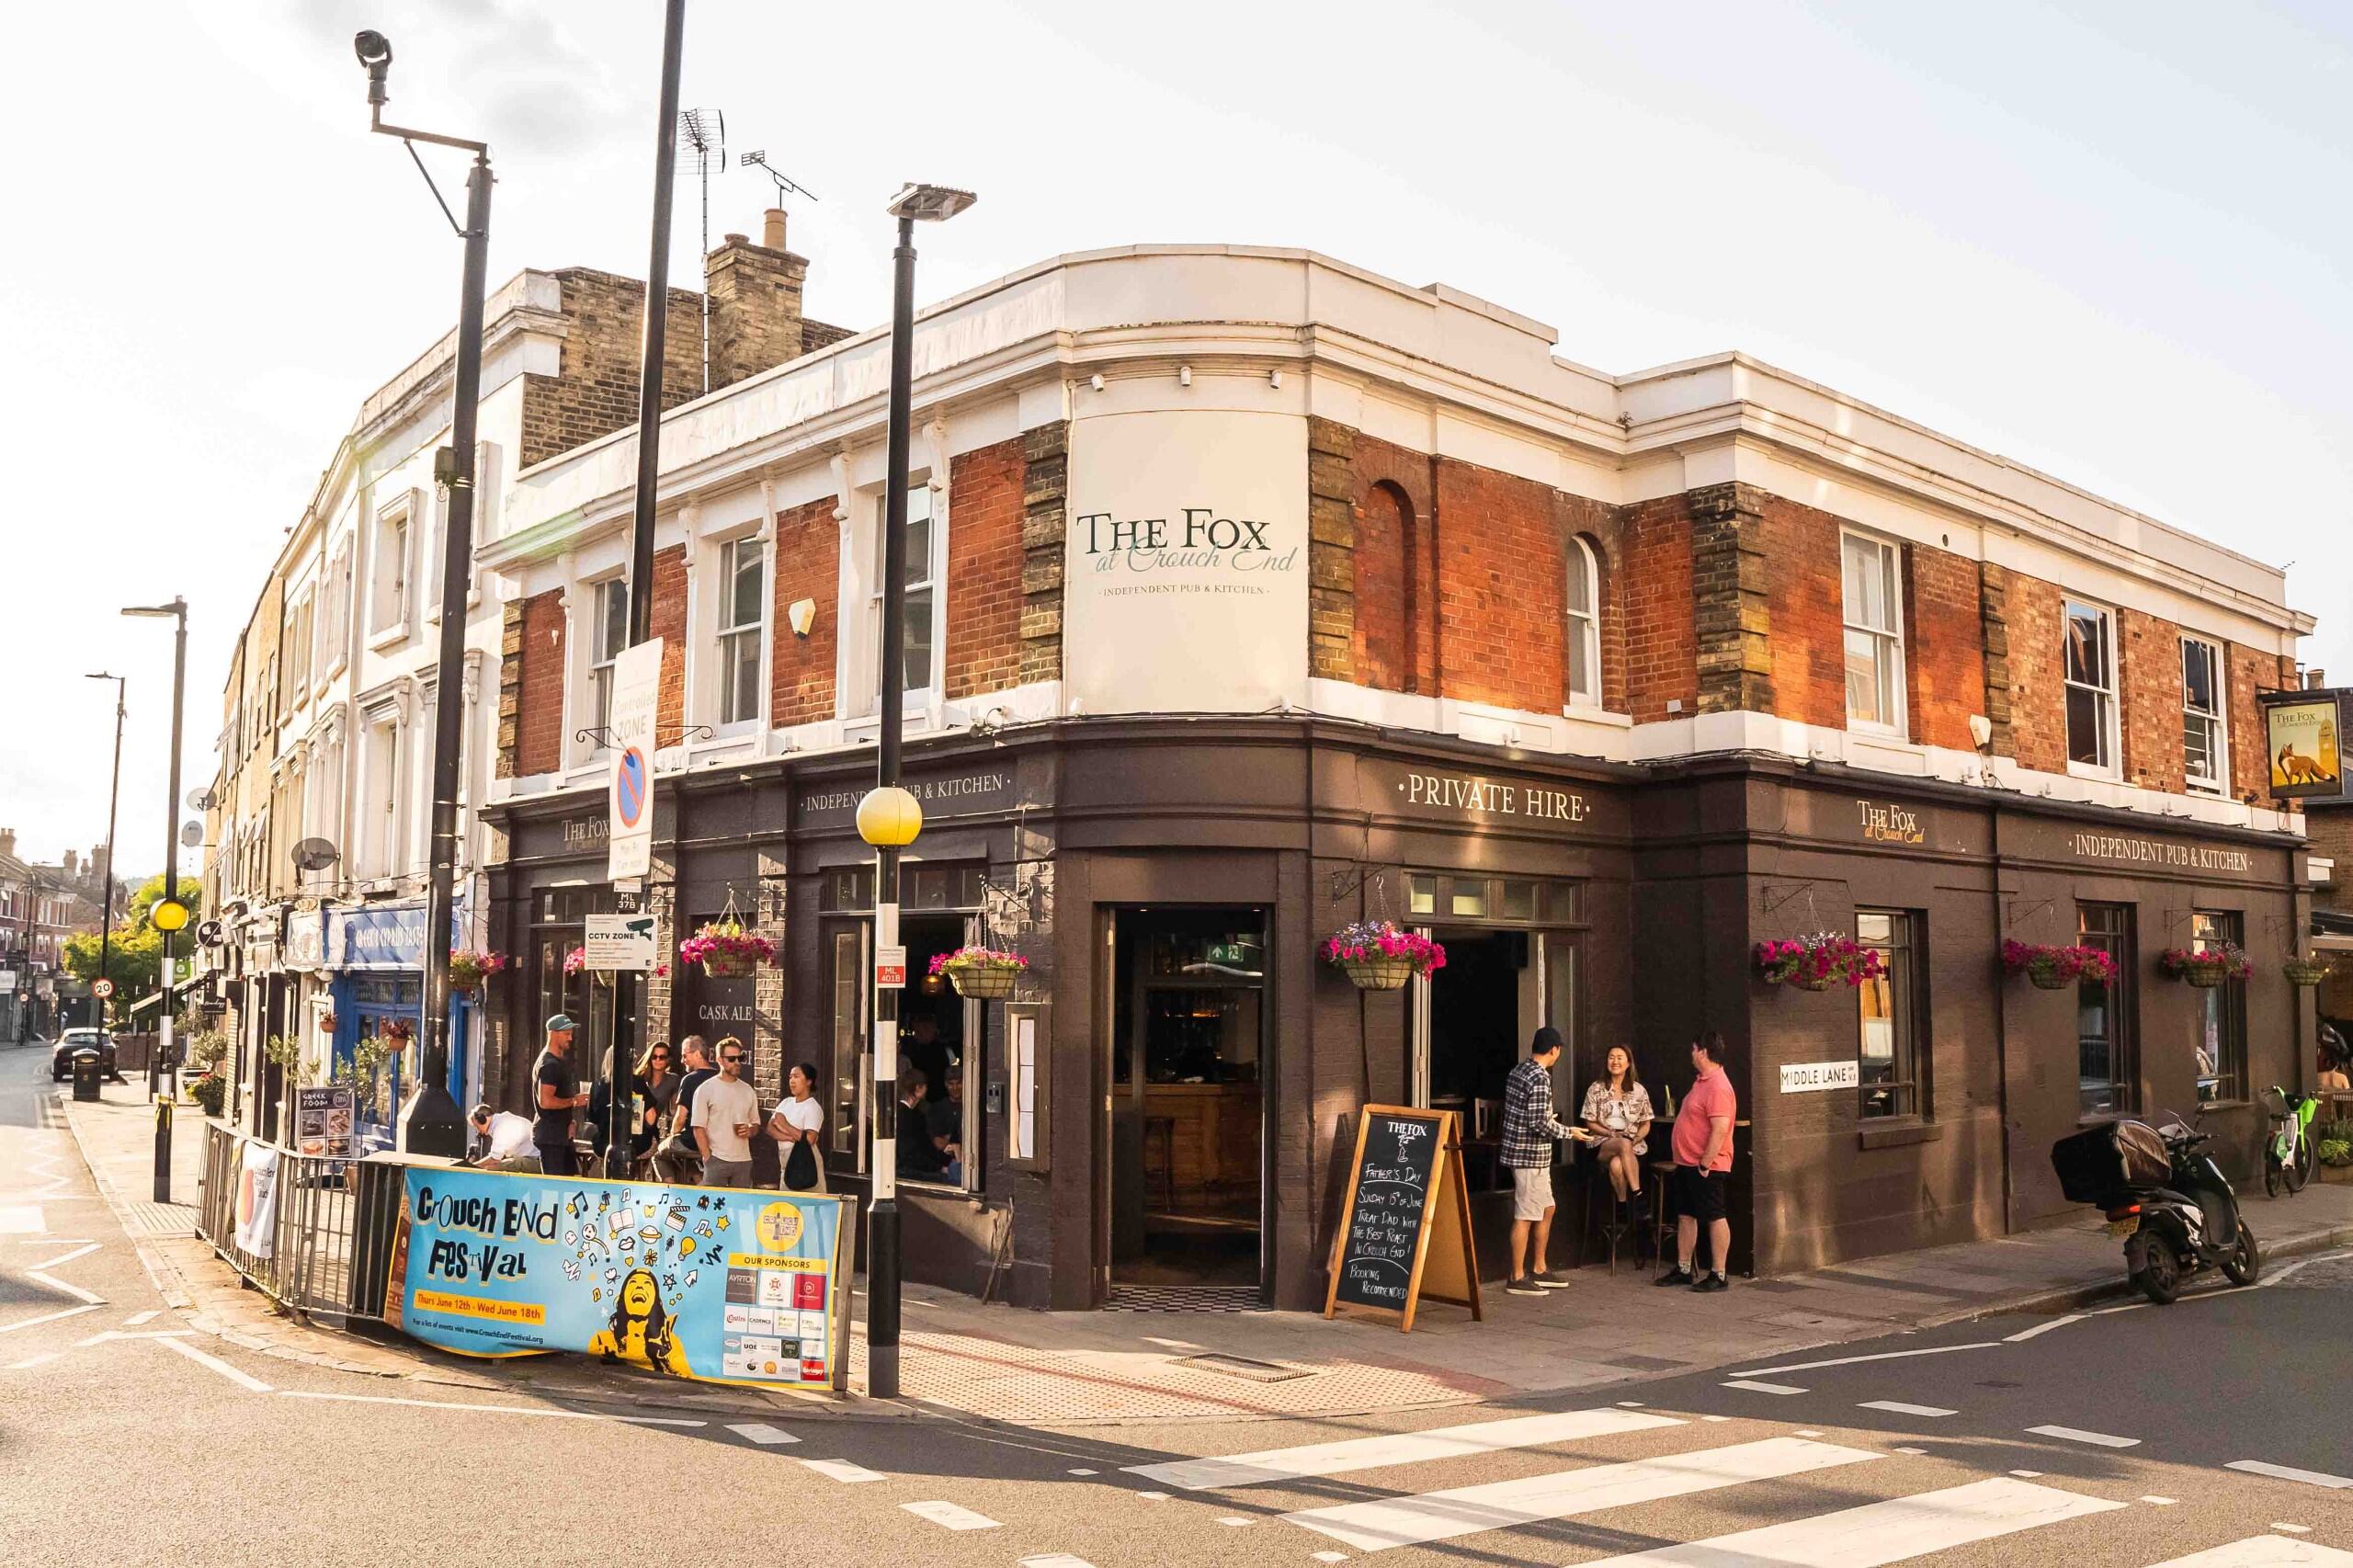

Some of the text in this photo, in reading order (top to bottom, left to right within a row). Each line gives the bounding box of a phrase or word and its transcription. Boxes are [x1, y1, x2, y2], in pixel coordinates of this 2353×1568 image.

[1076, 507, 1272, 554] THE FOX
[1096, 536, 1298, 573] at Crouch End
[1103, 584, 1265, 597] INDEPENDENT PUB & KITCHEN
[617, 713, 647, 741] ZONE
[925, 782, 934, 799] &
[938, 773, 1005, 798] KITCHEN
[1407, 774, 1584, 822] PRIVATE HIRE
[1857, 800, 1917, 832] THE FOX
[561, 819, 586, 842] THE
[2075, 834, 2248, 872] INDEPENDENT PUB & KITCHEN
[618, 900, 637, 910] 37B
[620, 892, 635, 902] ML
[881, 974, 901, 983] 401B
[884, 966, 897, 975] ML
[96, 983, 110, 994] 20
[699, 1004, 753, 1021] CASK ALE
[1781, 1067, 1847, 1086] MIDDLE LANE
[302, 1093, 325, 1101] GREEK
[1365, 1163, 1421, 1183] FATHER'S DAY
[744, 1256, 811, 1269] OUR SPONSORS
[417, 1293, 435, 1305] Thurs
[436, 1296, 452, 1308] June
[454, 1299, 471, 1311] 12th
[477, 1301, 495, 1314] Wed
[496, 1305, 517, 1317] June
[520, 1307, 540, 1320] 18th
